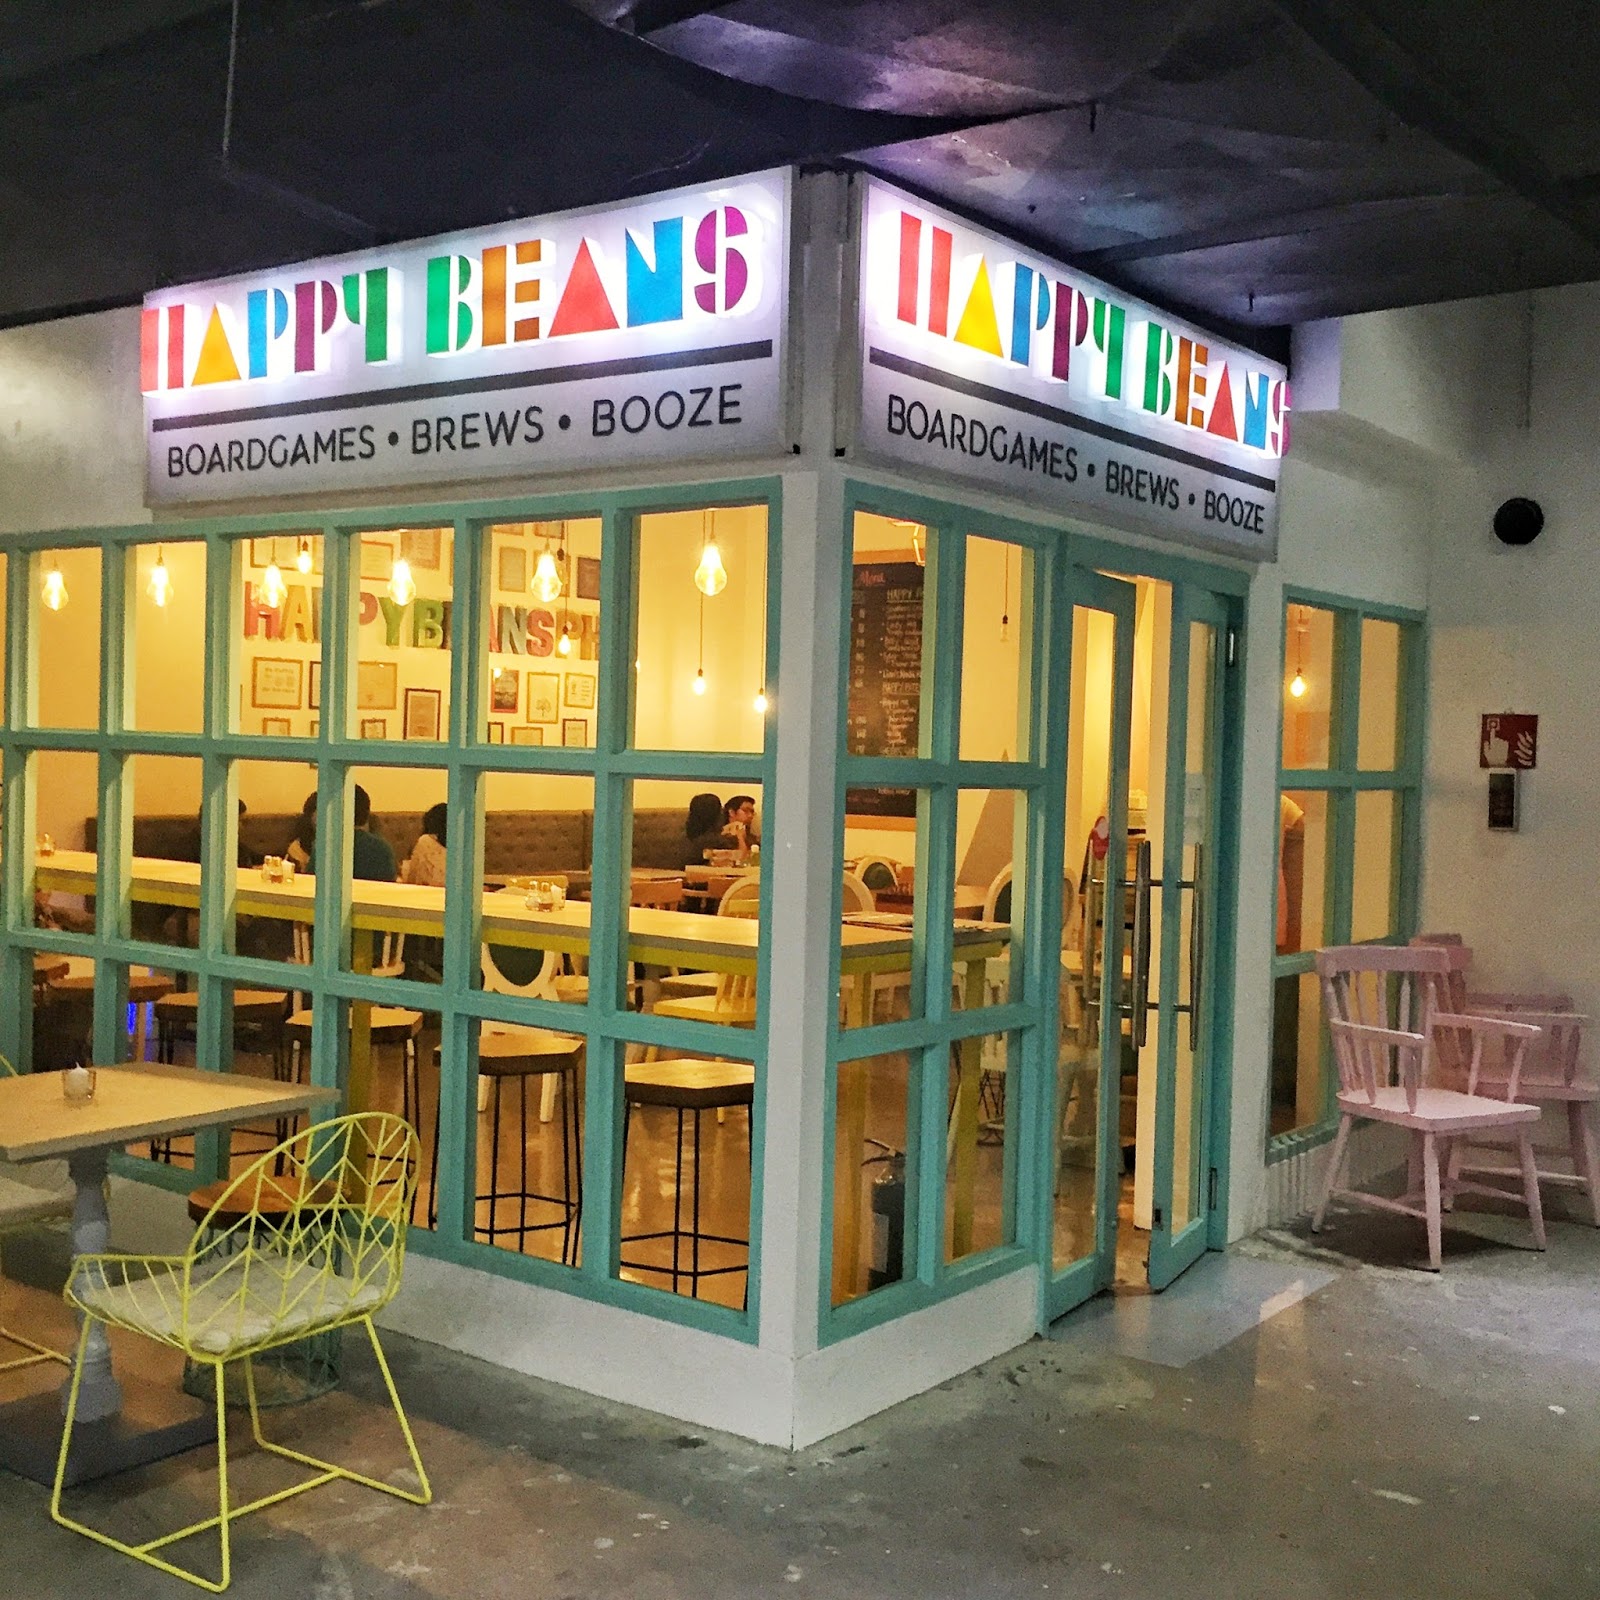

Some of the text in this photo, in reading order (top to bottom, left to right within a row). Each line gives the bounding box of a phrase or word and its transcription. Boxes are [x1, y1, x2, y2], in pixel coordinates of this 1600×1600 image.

[141, 205, 749, 392] HAPPY BEANS
[897, 210, 1292, 458] HAPPY BEANS
[167, 383, 743, 478] BOARDGAMES BREWS BOOZE
[887, 393, 1265, 534] BOARDGAMES BREWS BOOZE
